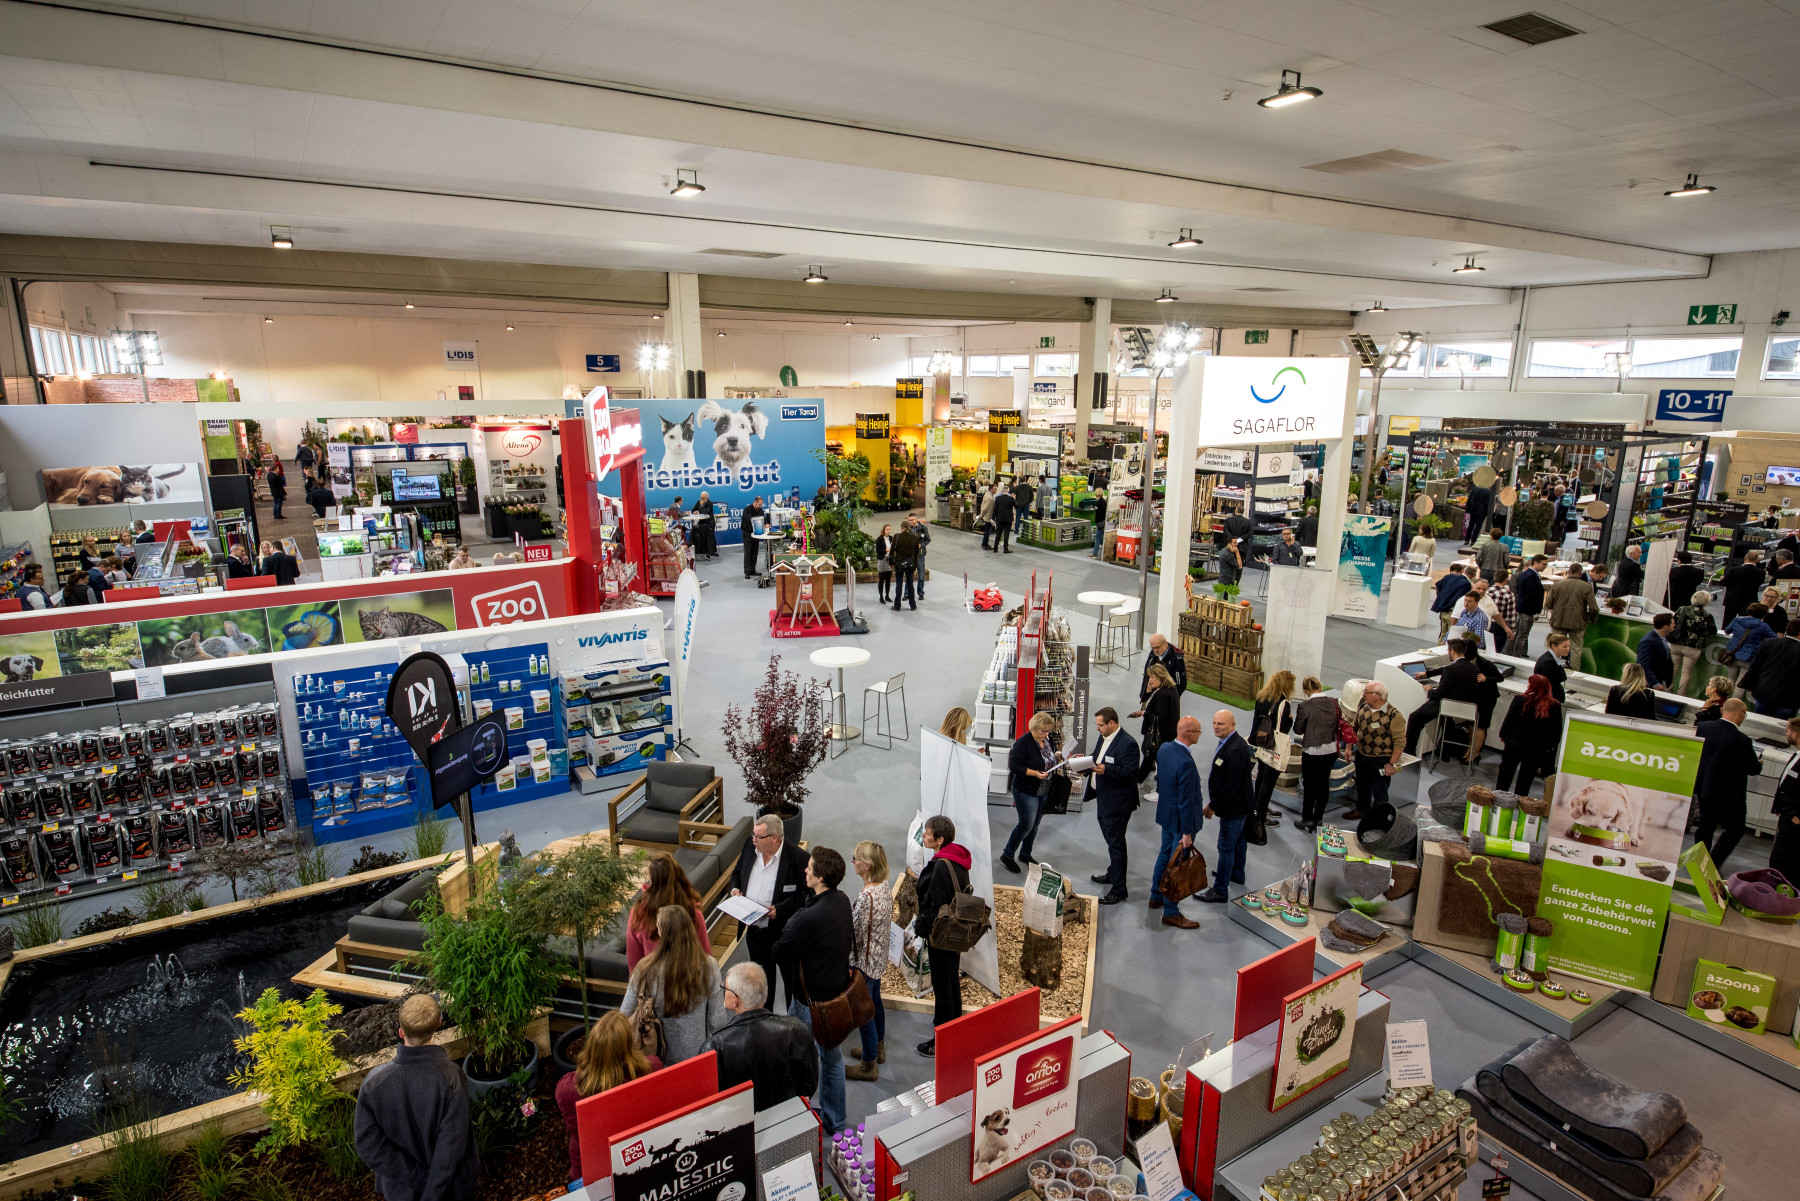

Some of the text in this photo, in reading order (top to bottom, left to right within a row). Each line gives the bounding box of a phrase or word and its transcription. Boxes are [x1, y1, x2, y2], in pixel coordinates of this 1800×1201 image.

[447, 351, 474, 359] LIDIS
[597, 356, 604, 366] 5
[1031, 396, 1065, 407] Landgard
[783, 408, 798, 416] Tier
[1233, 416, 1315, 434] SAGAFLOR
[506, 441, 529, 449] Altena
[643, 461, 780, 490] ierisch gut
[527, 549, 549, 559] NEU
[487, 597, 537, 620] ZOO
[578, 627, 648, 648] VIVANTIS
[0, 686, 56, 701] Teichfutter
[1580, 741, 1680, 773] azoona
[1552, 884, 1654, 915] Entdecken Sie die
[1544, 896, 1657, 929] ganze Zubehörwelt
[1562, 912, 1632, 936] von azoona.
[1706, 973, 1760, 993] azoona
[987, 1066, 1000, 1077] ZOO
[1025, 1061, 1061, 1084] arriba
[624, 1143, 642, 1157] ZOO
[631, 1151, 645, 1160] Co.
[640, 1155, 734, 1201] MAJESTIC
[770, 1184, 791, 1198] Aktion
